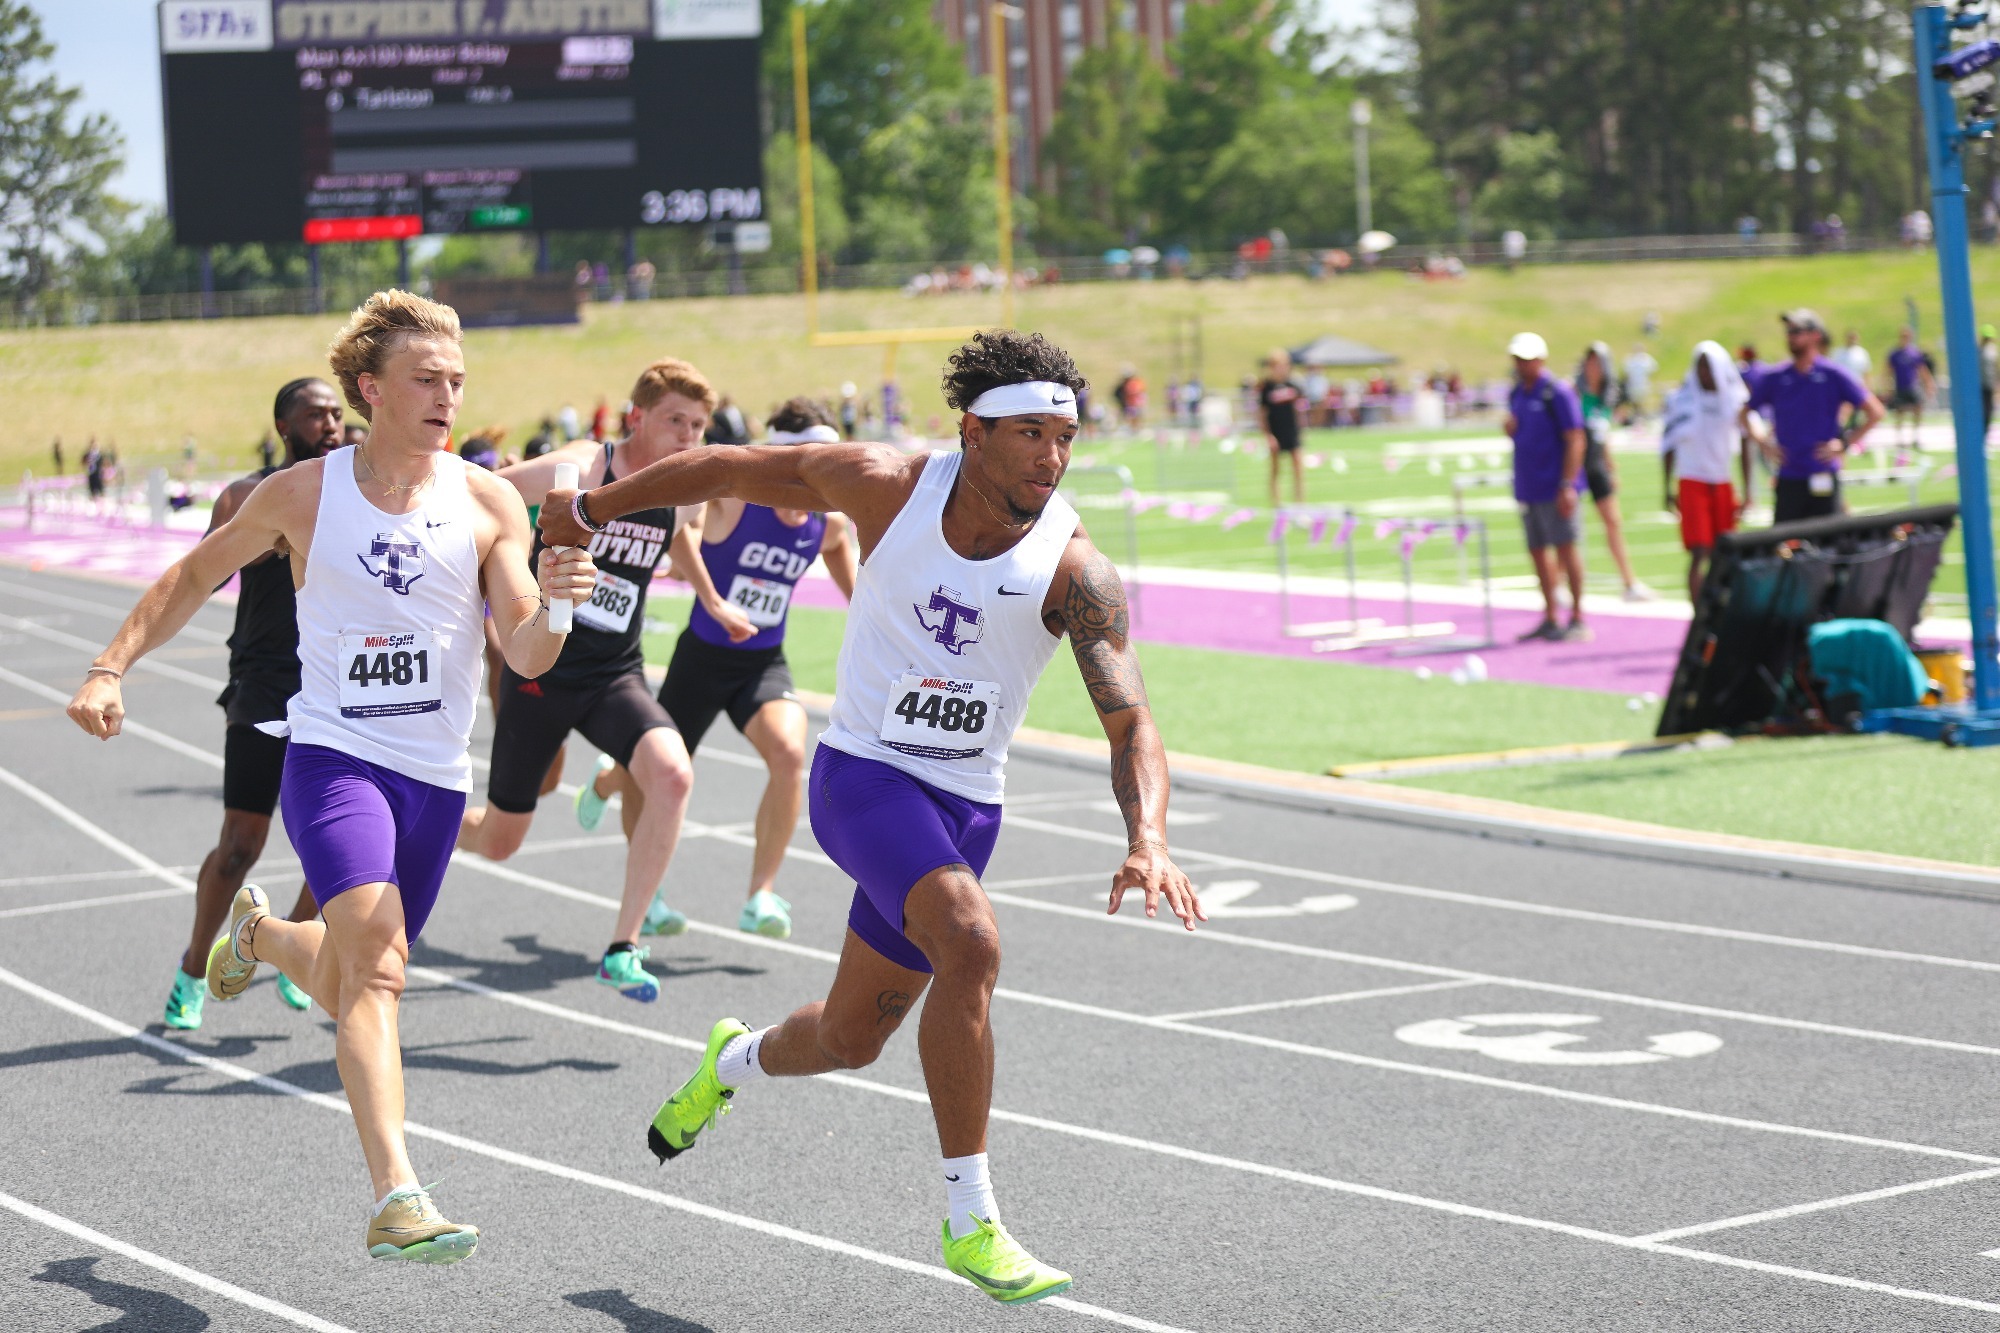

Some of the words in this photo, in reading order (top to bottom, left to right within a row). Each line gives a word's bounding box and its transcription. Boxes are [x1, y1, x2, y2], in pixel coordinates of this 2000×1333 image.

[709, 187, 762, 220] PM
[587, 532, 663, 568] UTAH
[739, 541, 809, 581] GCU
[588, 584, 632, 617] 363
[736, 588, 783, 614] 4210
[364, 634, 414, 648] MileSplit
[348, 650, 428, 687] 4481
[920, 678, 974, 695] MileSplit
[894, 691, 988, 734] 4488
